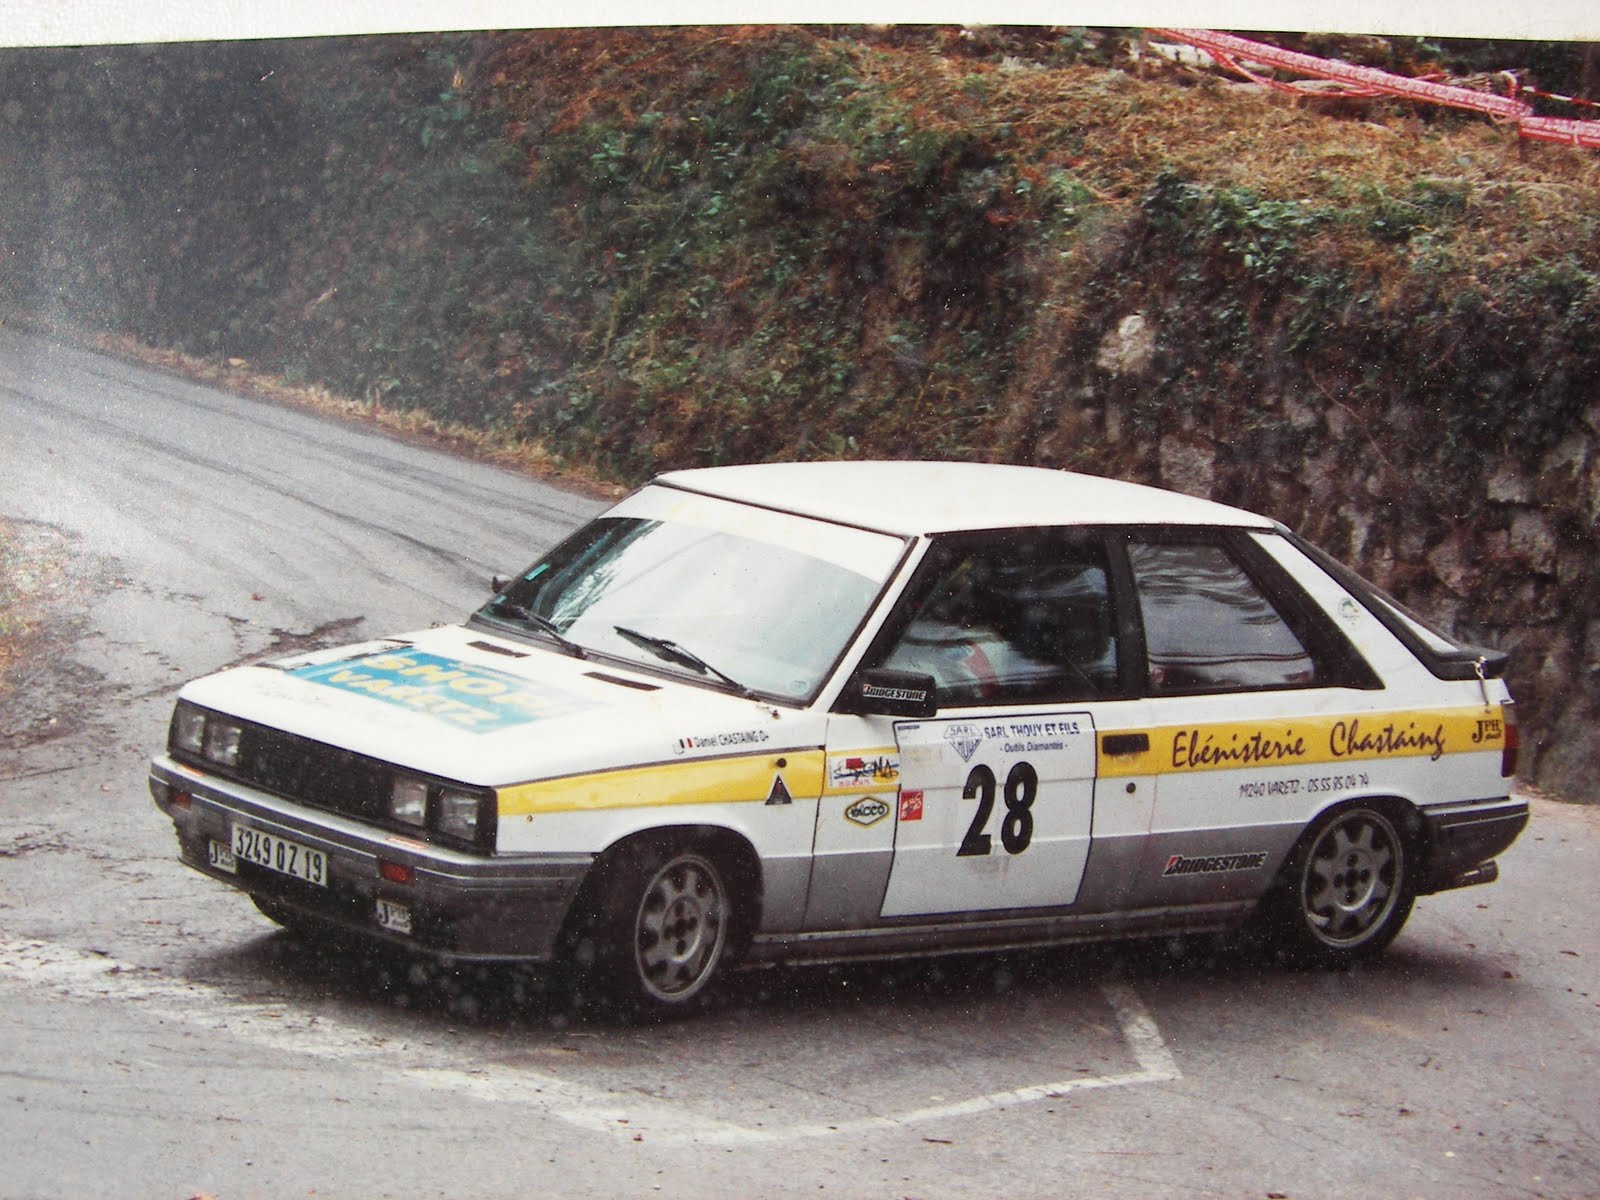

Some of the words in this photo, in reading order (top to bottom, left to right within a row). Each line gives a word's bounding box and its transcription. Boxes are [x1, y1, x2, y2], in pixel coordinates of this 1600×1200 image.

[863, 683, 927, 701] BRIDGESTONE
[719, 730, 759, 745] CHASTAING
[985, 727, 1008, 738] SARL
[1010, 725, 1042, 737] THOUY
[1045, 723, 1058, 735] ET
[1060, 722, 1080, 735] FILS
[1005, 742, 1025, 753] Outils
[1172, 729, 1306, 768] Ebénisterie
[1330, 718, 1446, 761] Chastaing
[1268, 779, 1300, 796] VARETZ
[1320, 777, 1331, 791] 55
[956, 762, 1038, 856] 28
[235, 827, 271, 866] 3249
[304, 850, 323, 883] 19
[1162, 853, 1267, 876] BRIDGESTONE
